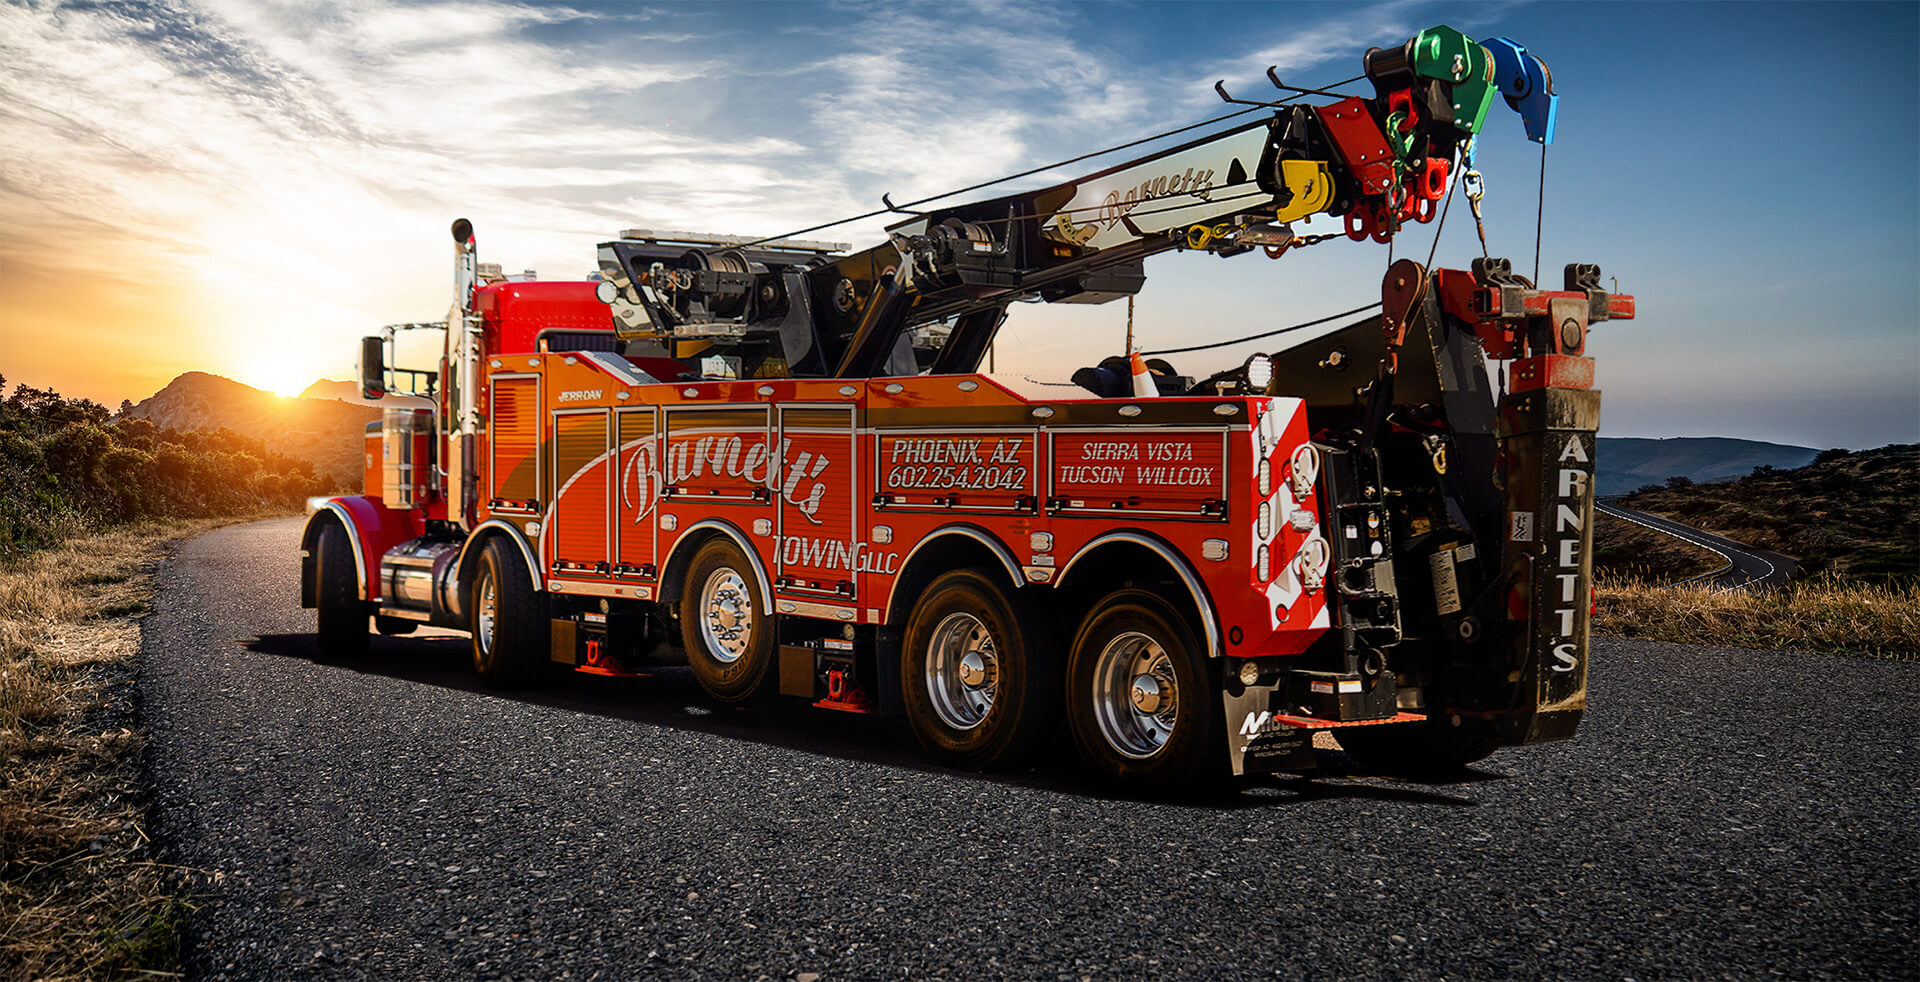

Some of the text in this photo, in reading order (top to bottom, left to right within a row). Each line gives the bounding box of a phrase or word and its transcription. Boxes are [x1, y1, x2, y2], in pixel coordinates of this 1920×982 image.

[1099, 166, 1215, 231] Barnett's
[891, 438, 1025, 465] PHOENIX, AZ
[1080, 442, 1193, 461] SIERRA VISTA
[622, 434, 831, 524] Barnett's
[887, 465, 1028, 489] 602.254.2042
[1060, 465, 1214, 486] TUCSON WILLCOX
[772, 534, 899, 575] TOWING LLC
